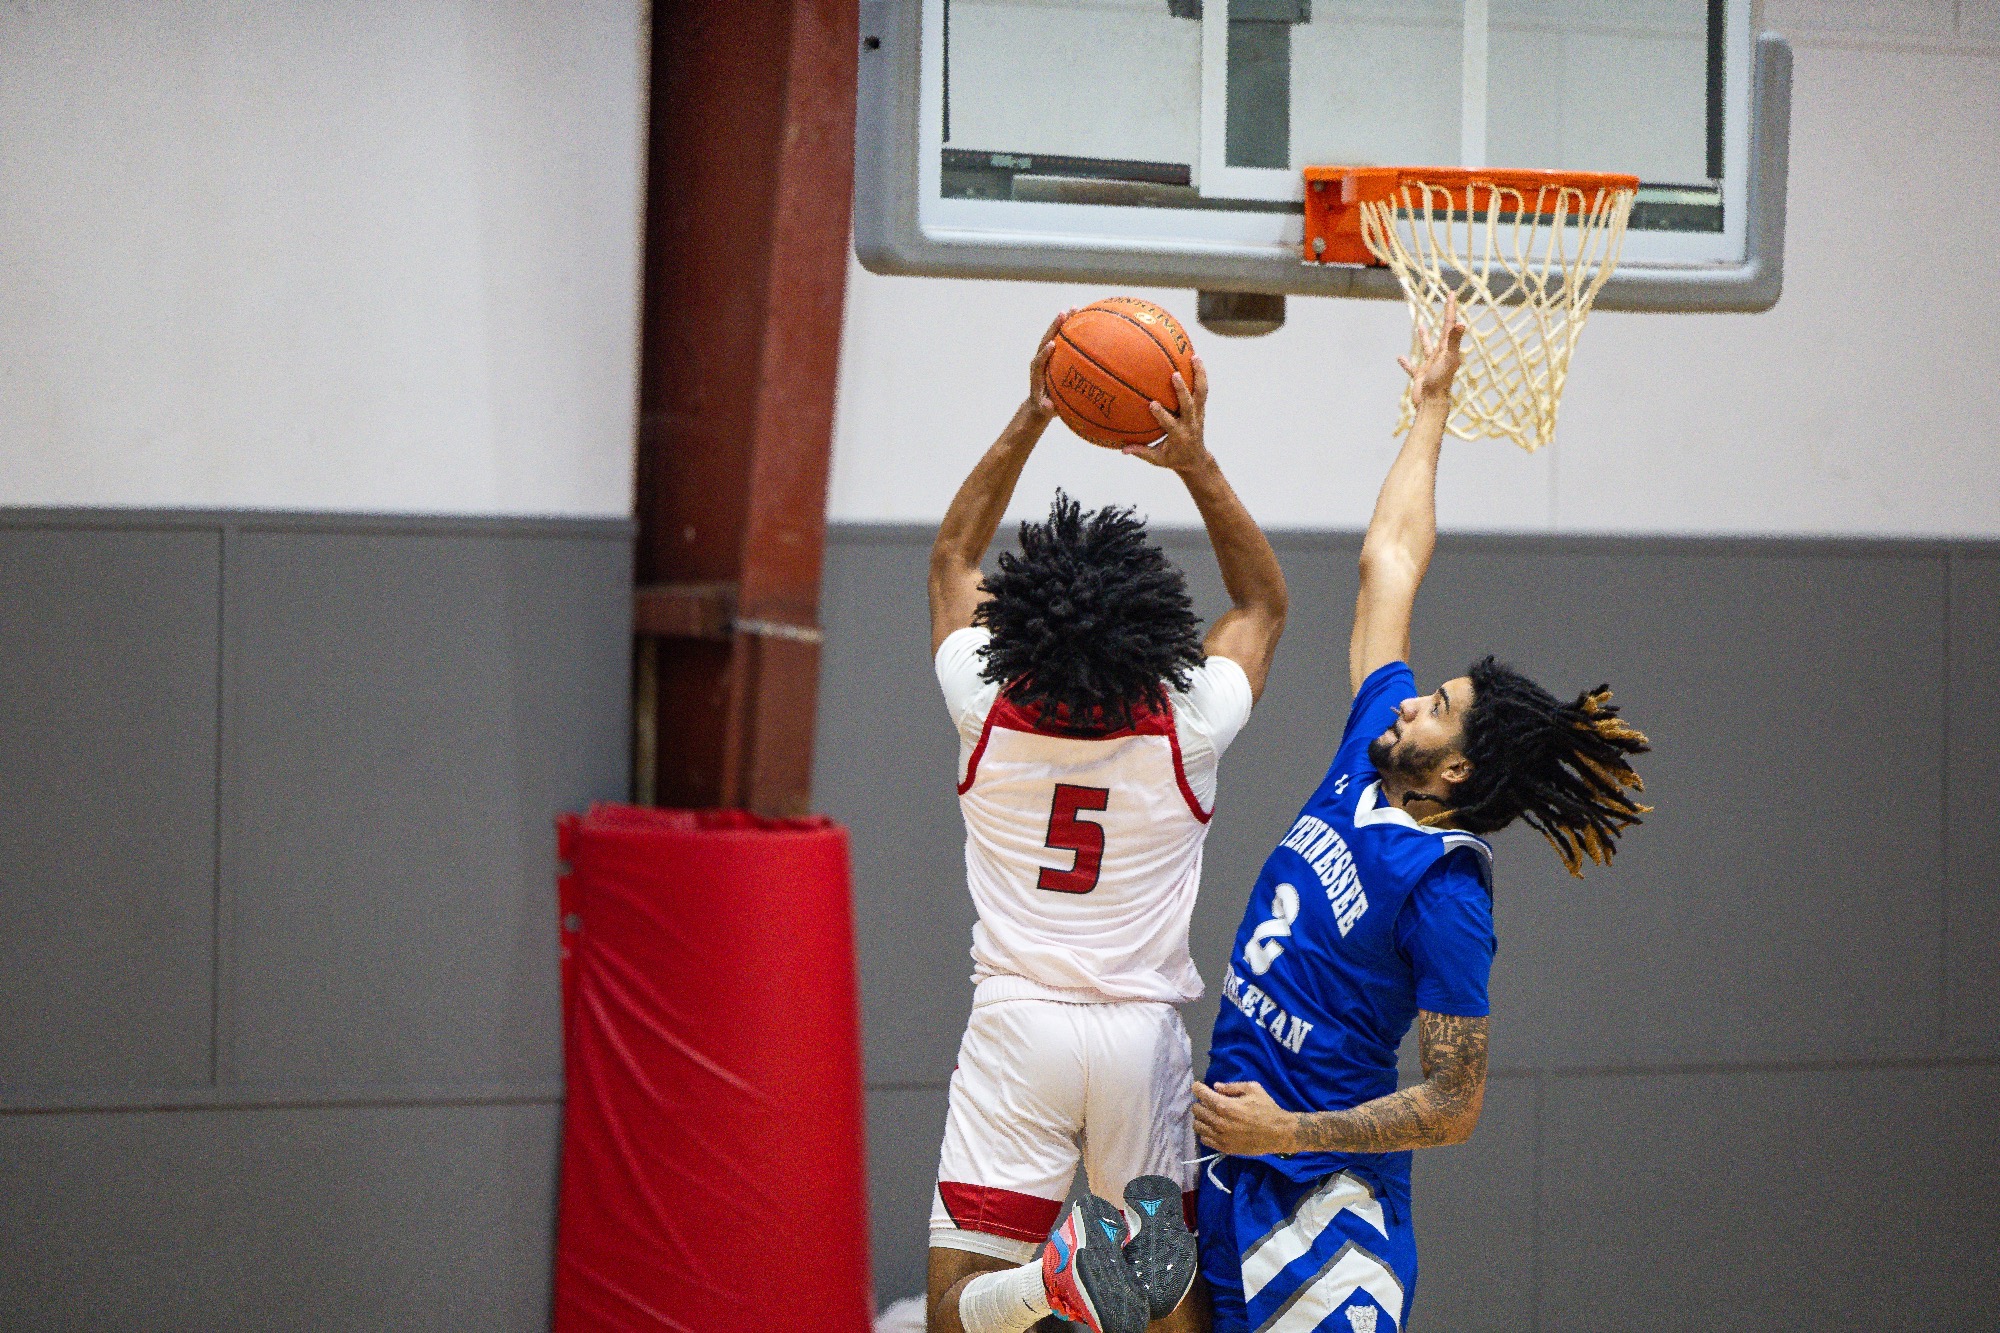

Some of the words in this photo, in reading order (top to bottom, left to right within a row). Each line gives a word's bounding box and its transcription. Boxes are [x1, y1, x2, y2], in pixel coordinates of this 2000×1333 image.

[1037, 783, 1109, 894] 5
[1279, 815, 1369, 938] TENNESSEE
[1243, 883, 1300, 976] 2
